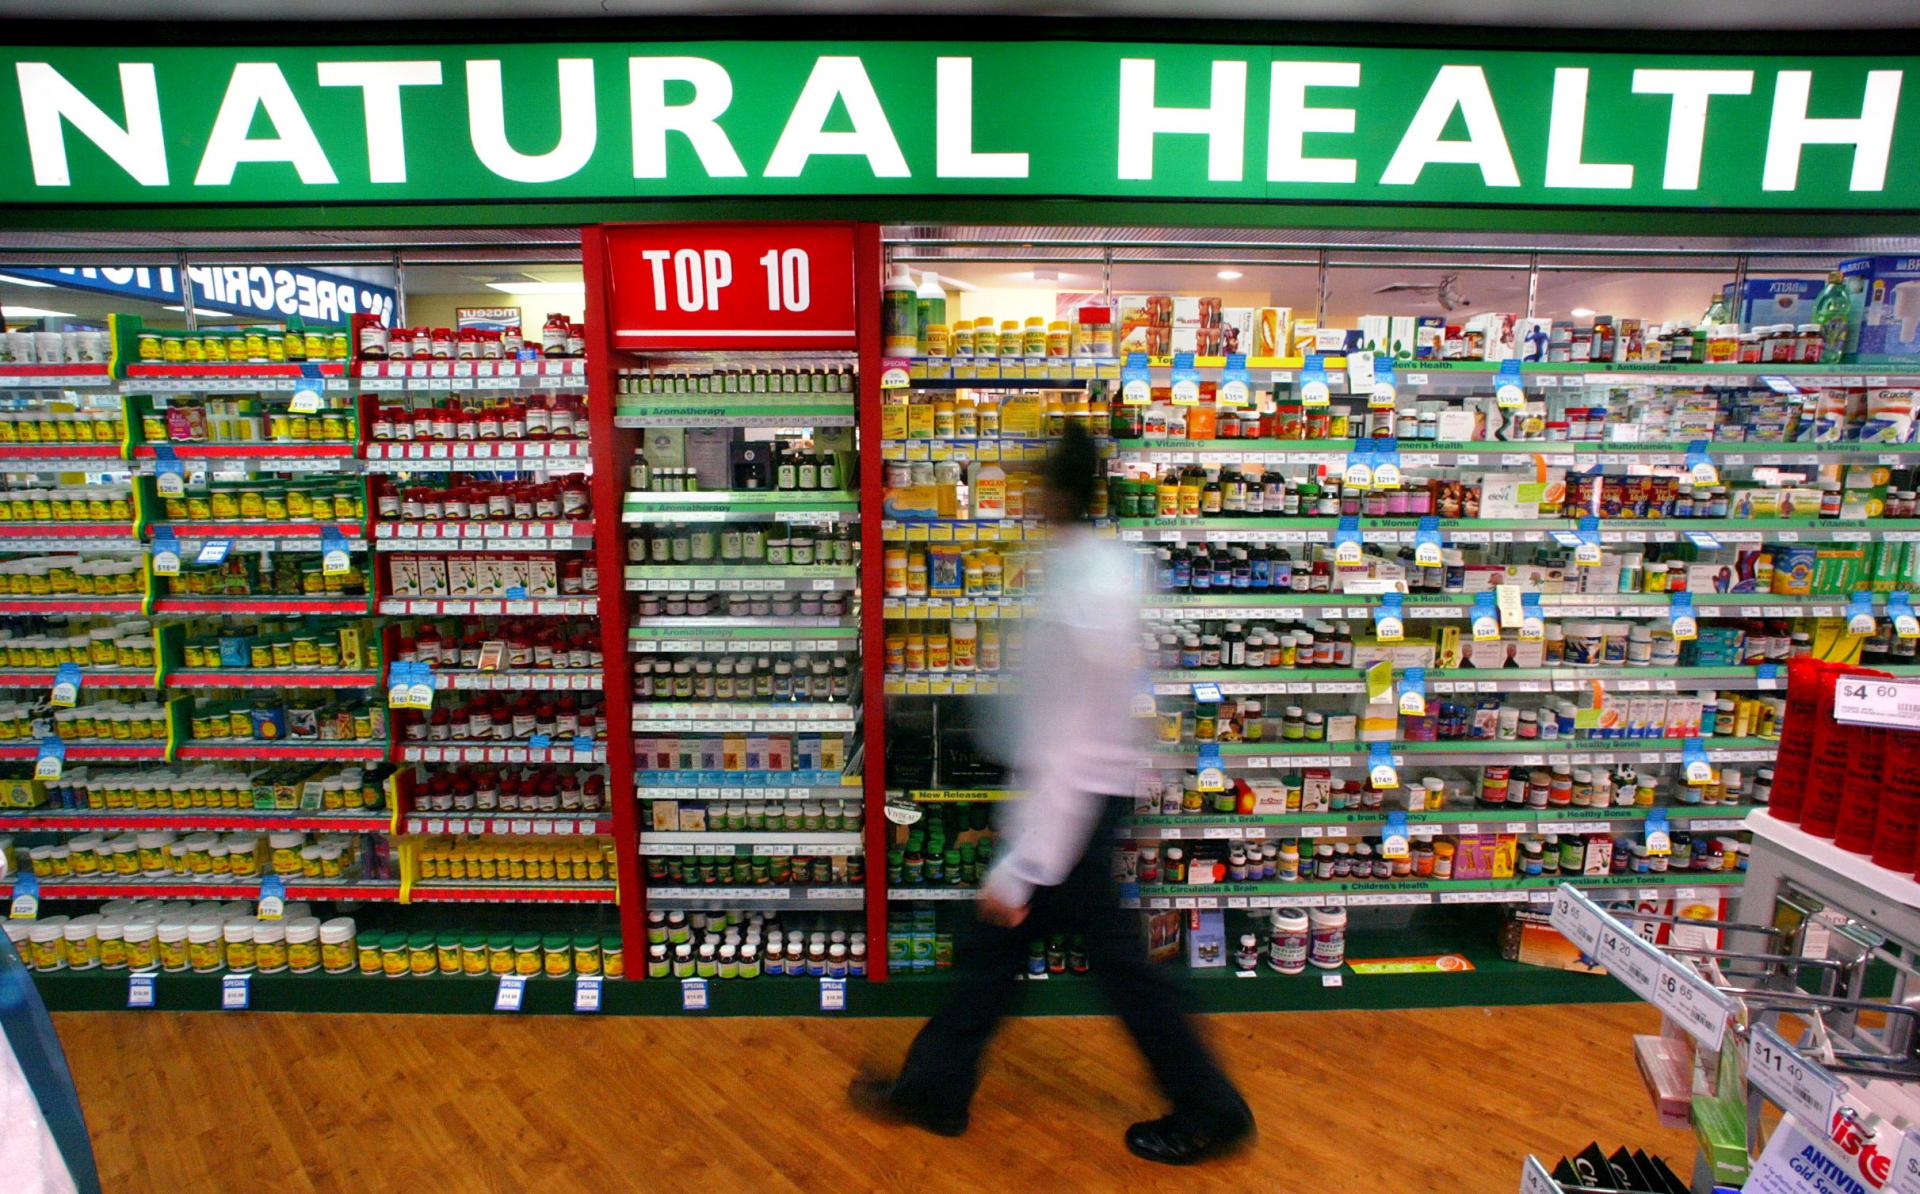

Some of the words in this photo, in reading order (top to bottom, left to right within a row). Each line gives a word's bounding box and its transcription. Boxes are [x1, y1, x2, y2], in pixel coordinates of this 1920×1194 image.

[16, 56, 1031, 188] NATURAL
[1116, 58, 1904, 194] HEALTH
[642, 248, 732, 312] TOP
[760, 248, 811, 312] 10
[1420, 361, 1452, 369] Health
[653, 406, 727, 416] Aromatherapy
[1156, 440, 1194, 449] Vitamin
[1396, 441, 1427, 450] omen's
[1430, 441, 1464, 450] Health
[1609, 442, 1673, 451] Multivitamins
[1827, 443, 1860, 454] Energy
[658, 503, 732, 513] Aromatherapy
[1154, 518, 1177, 527] Cold
[663, 627, 734, 638] Aromatherapy
[1843, 685, 1868, 700] $4
[1877, 686, 1898, 699] 60
[1576, 738, 1610, 749] Healthy
[919, 791, 942, 800] New
[944, 790, 988, 800] Releases
[1357, 813, 1376, 822] Iron
[1568, 809, 1601, 819] Healthy
[1175, 815, 1228, 825] Circulation
[1352, 881, 1396, 890] Children's
[1399, 879, 1429, 889] Health
[1612, 876, 1635, 885] Liver
[1637, 875, 1666, 884] Tonics
[1170, 884, 1223, 894] Circulation
[1558, 899, 1569, 915] $3
[1604, 933, 1616, 951] $4
[1618, 942, 1631, 957] 20
[1661, 973, 1676, 993] $6
[1679, 985, 1693, 1001] 65
[1754, 1042, 1782, 1072] $11
[1786, 1064, 1803, 1081] 40
[1789, 1157, 1814, 1181] Cold
